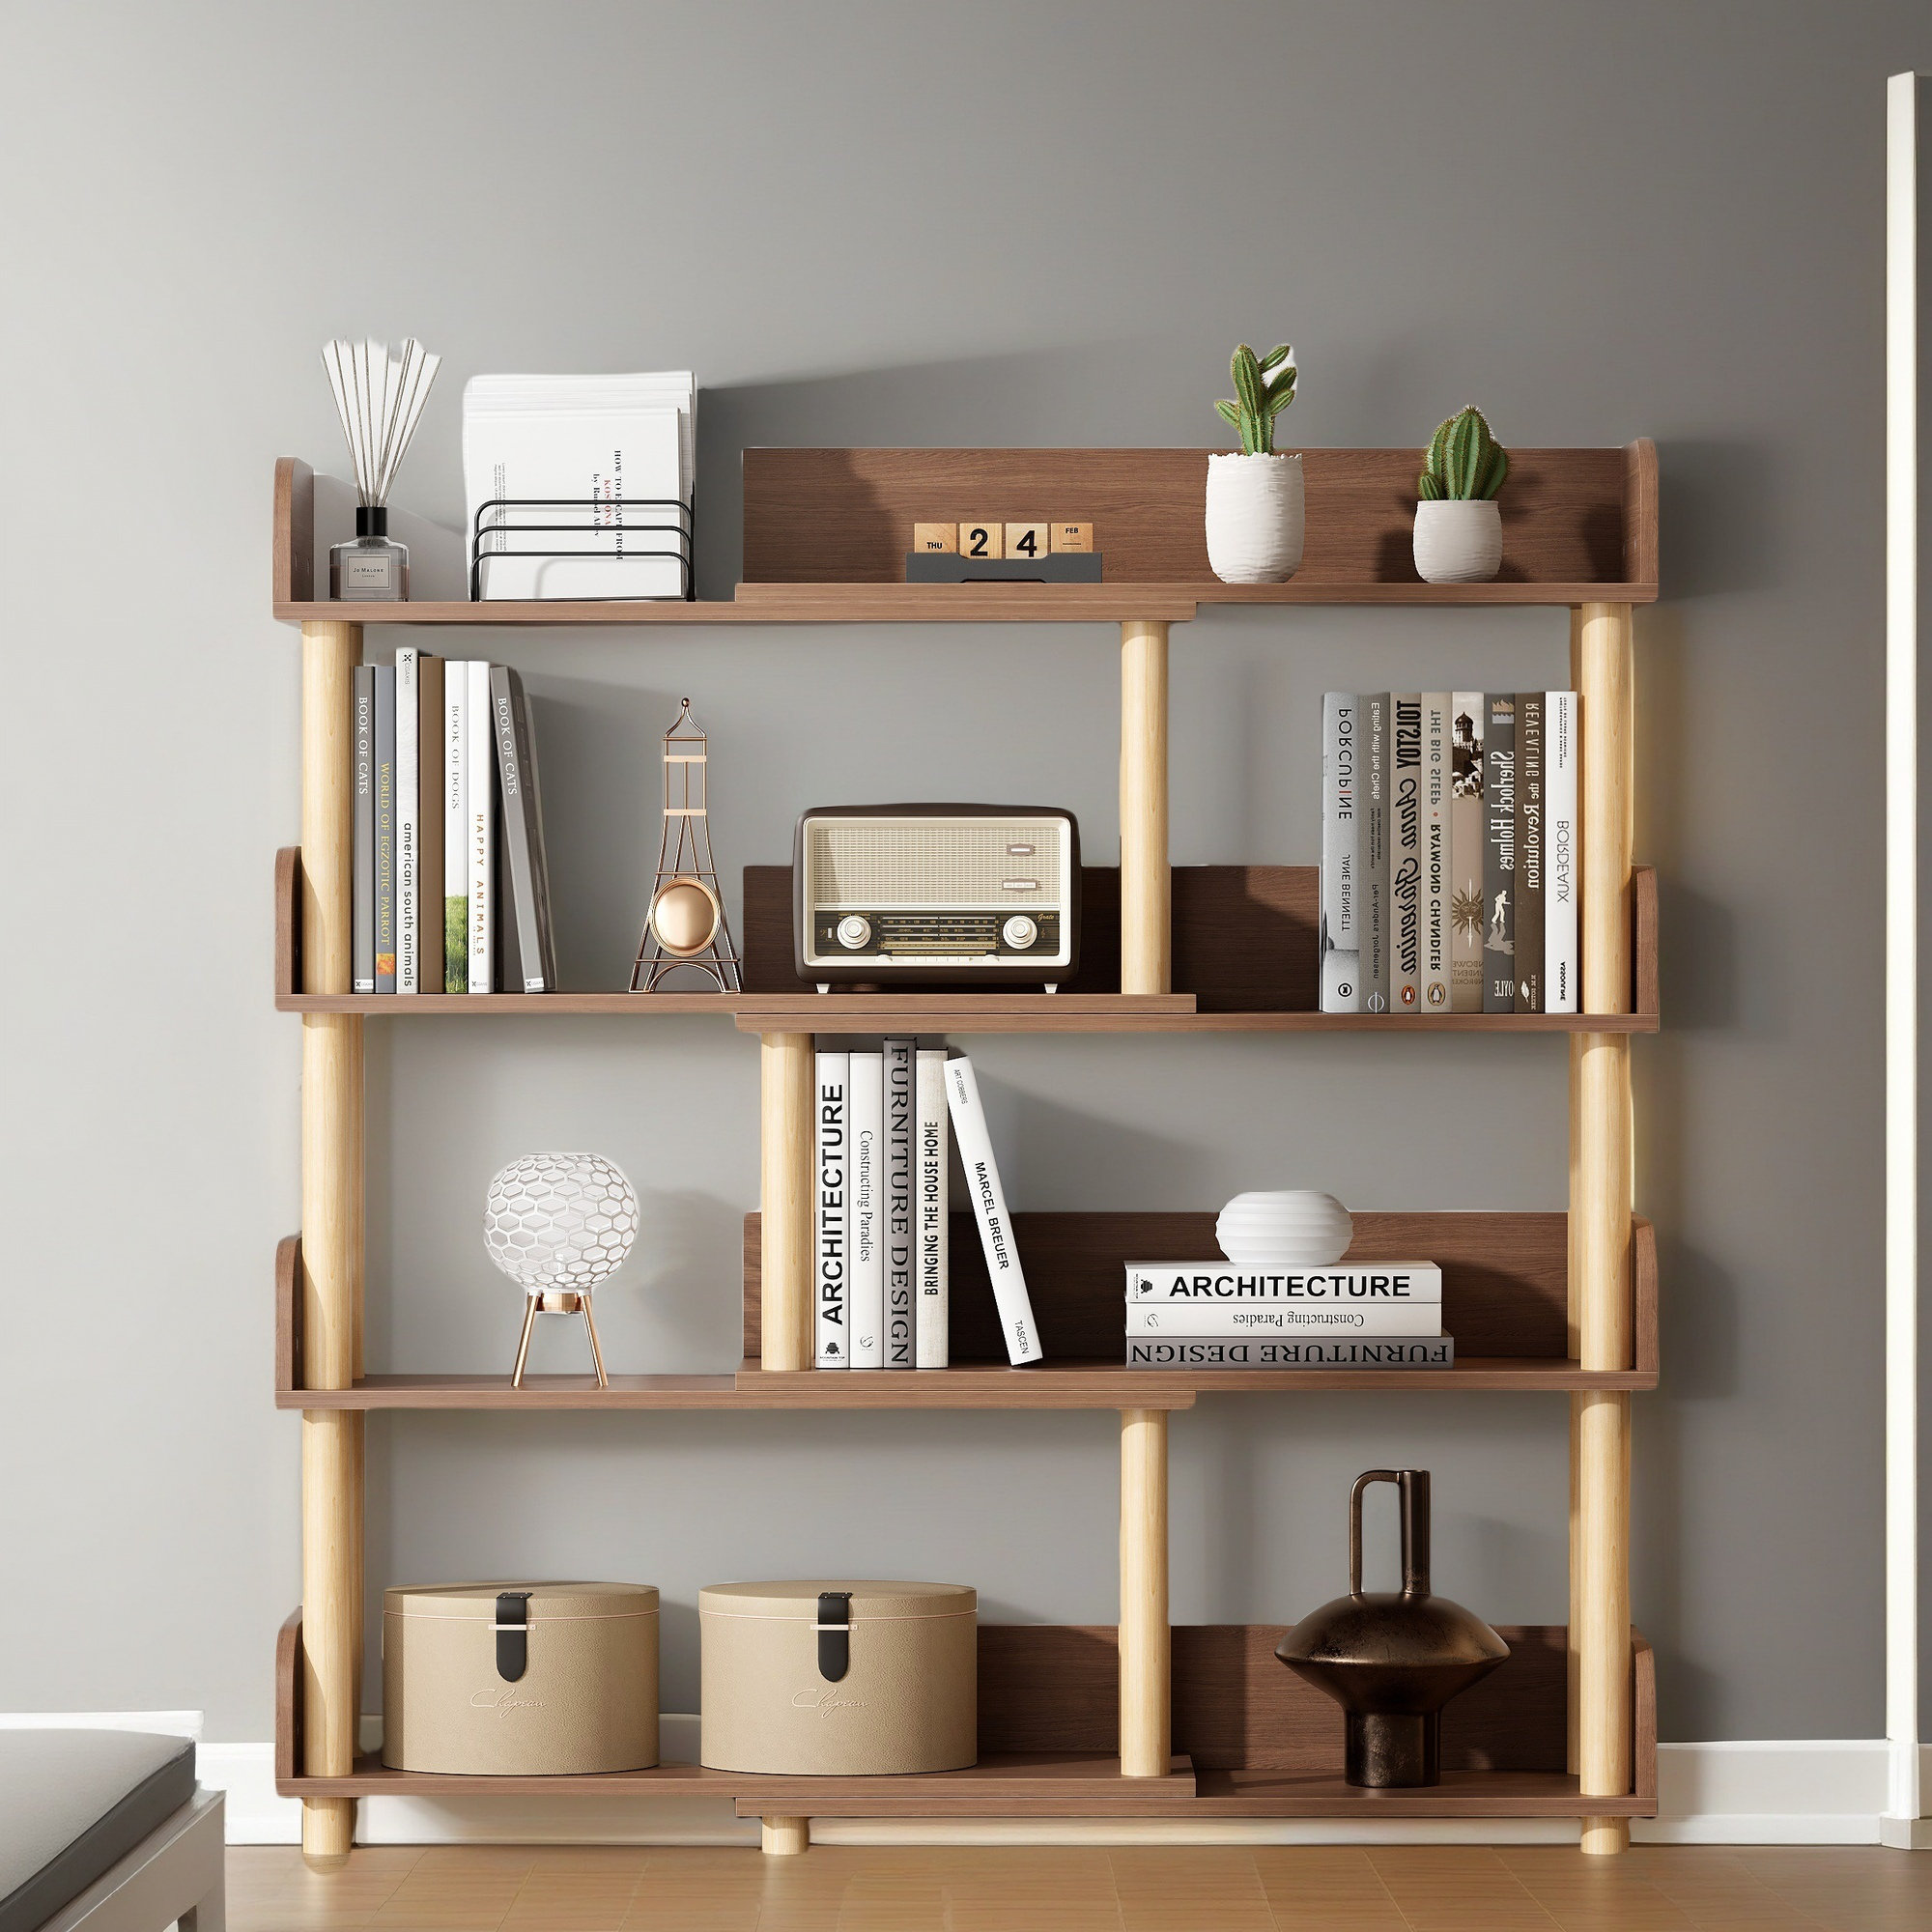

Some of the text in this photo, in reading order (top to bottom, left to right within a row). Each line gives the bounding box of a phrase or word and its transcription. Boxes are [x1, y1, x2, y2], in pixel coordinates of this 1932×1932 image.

[591, 474, 600, 483] by
[614, 476, 622, 490] TO
[926, 541, 943, 550] THU
[970, 528, 1037, 557] 2 4
[358, 696, 368, 795] BOOK OF CATS
[451, 705, 460, 810] BOOK OF DOGS
[497, 697, 518, 795] BOOK OF CATS
[380, 762, 390, 946] WORLD OF EGZOTIC PARROT
[476, 814, 485, 955] HAPPY ANIMALS
[404, 822, 414, 987] american south animals
[821, 1084, 843, 1326] ARCHITECTURE
[857, 1129, 874, 1262] Constructing Paradies
[891, 1046, 909, 1364] FURNITURE DESIGN
[923, 1122, 939, 1295] BRINGING THE HOUSE HOME
[975, 1161, 1009, 1270] MARCEL BREUER
[1169, 1275, 1410, 1297] ARCHITECTURE
[1233, 1311, 1364, 1327] Constructing Paradies
[1014, 1320, 1030, 1354] TASCEN
[1132, 1344, 1448, 1363] FURNITURE DESIGN
